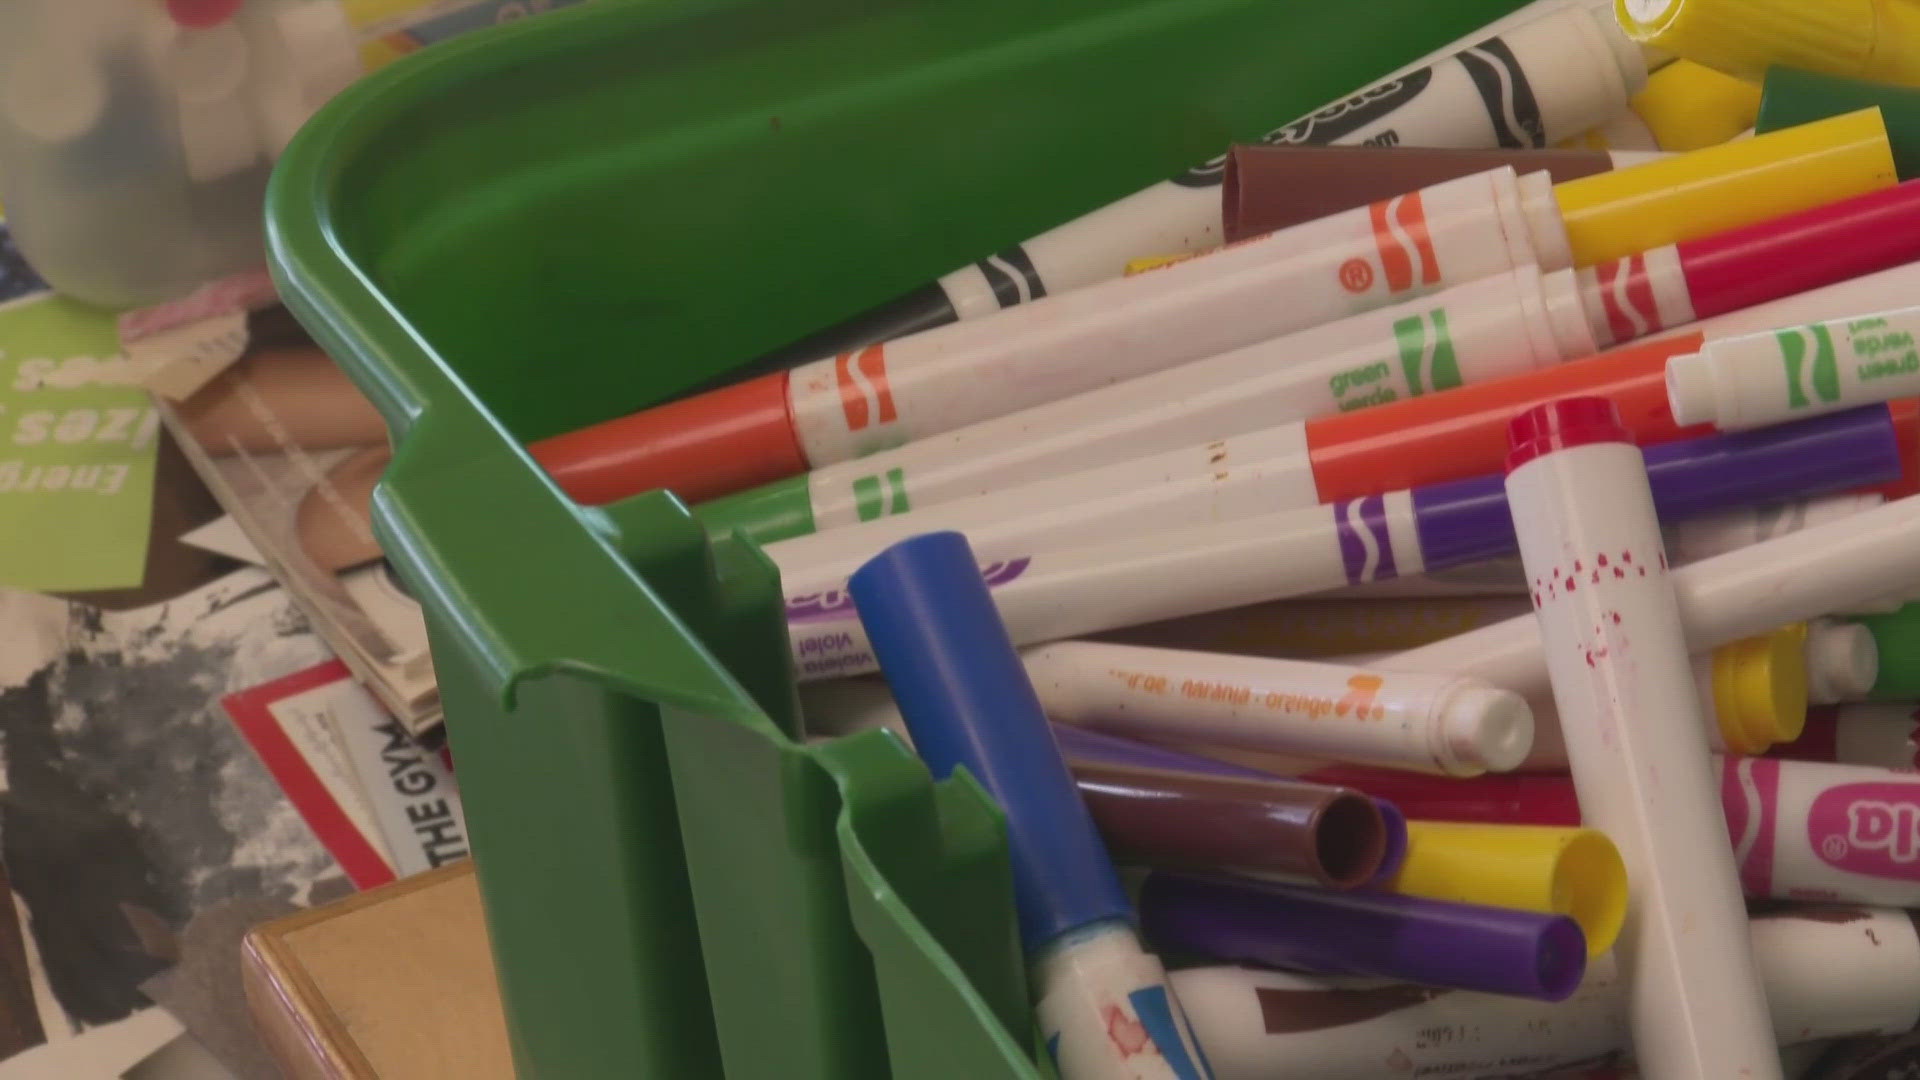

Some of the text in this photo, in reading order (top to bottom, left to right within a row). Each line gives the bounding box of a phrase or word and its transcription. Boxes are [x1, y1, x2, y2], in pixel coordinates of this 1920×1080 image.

[1330, 361, 1389, 397] green
[1858, 350, 1920, 381] green
[799, 632, 852, 656] violet
[405, 799, 469, 868] THE
